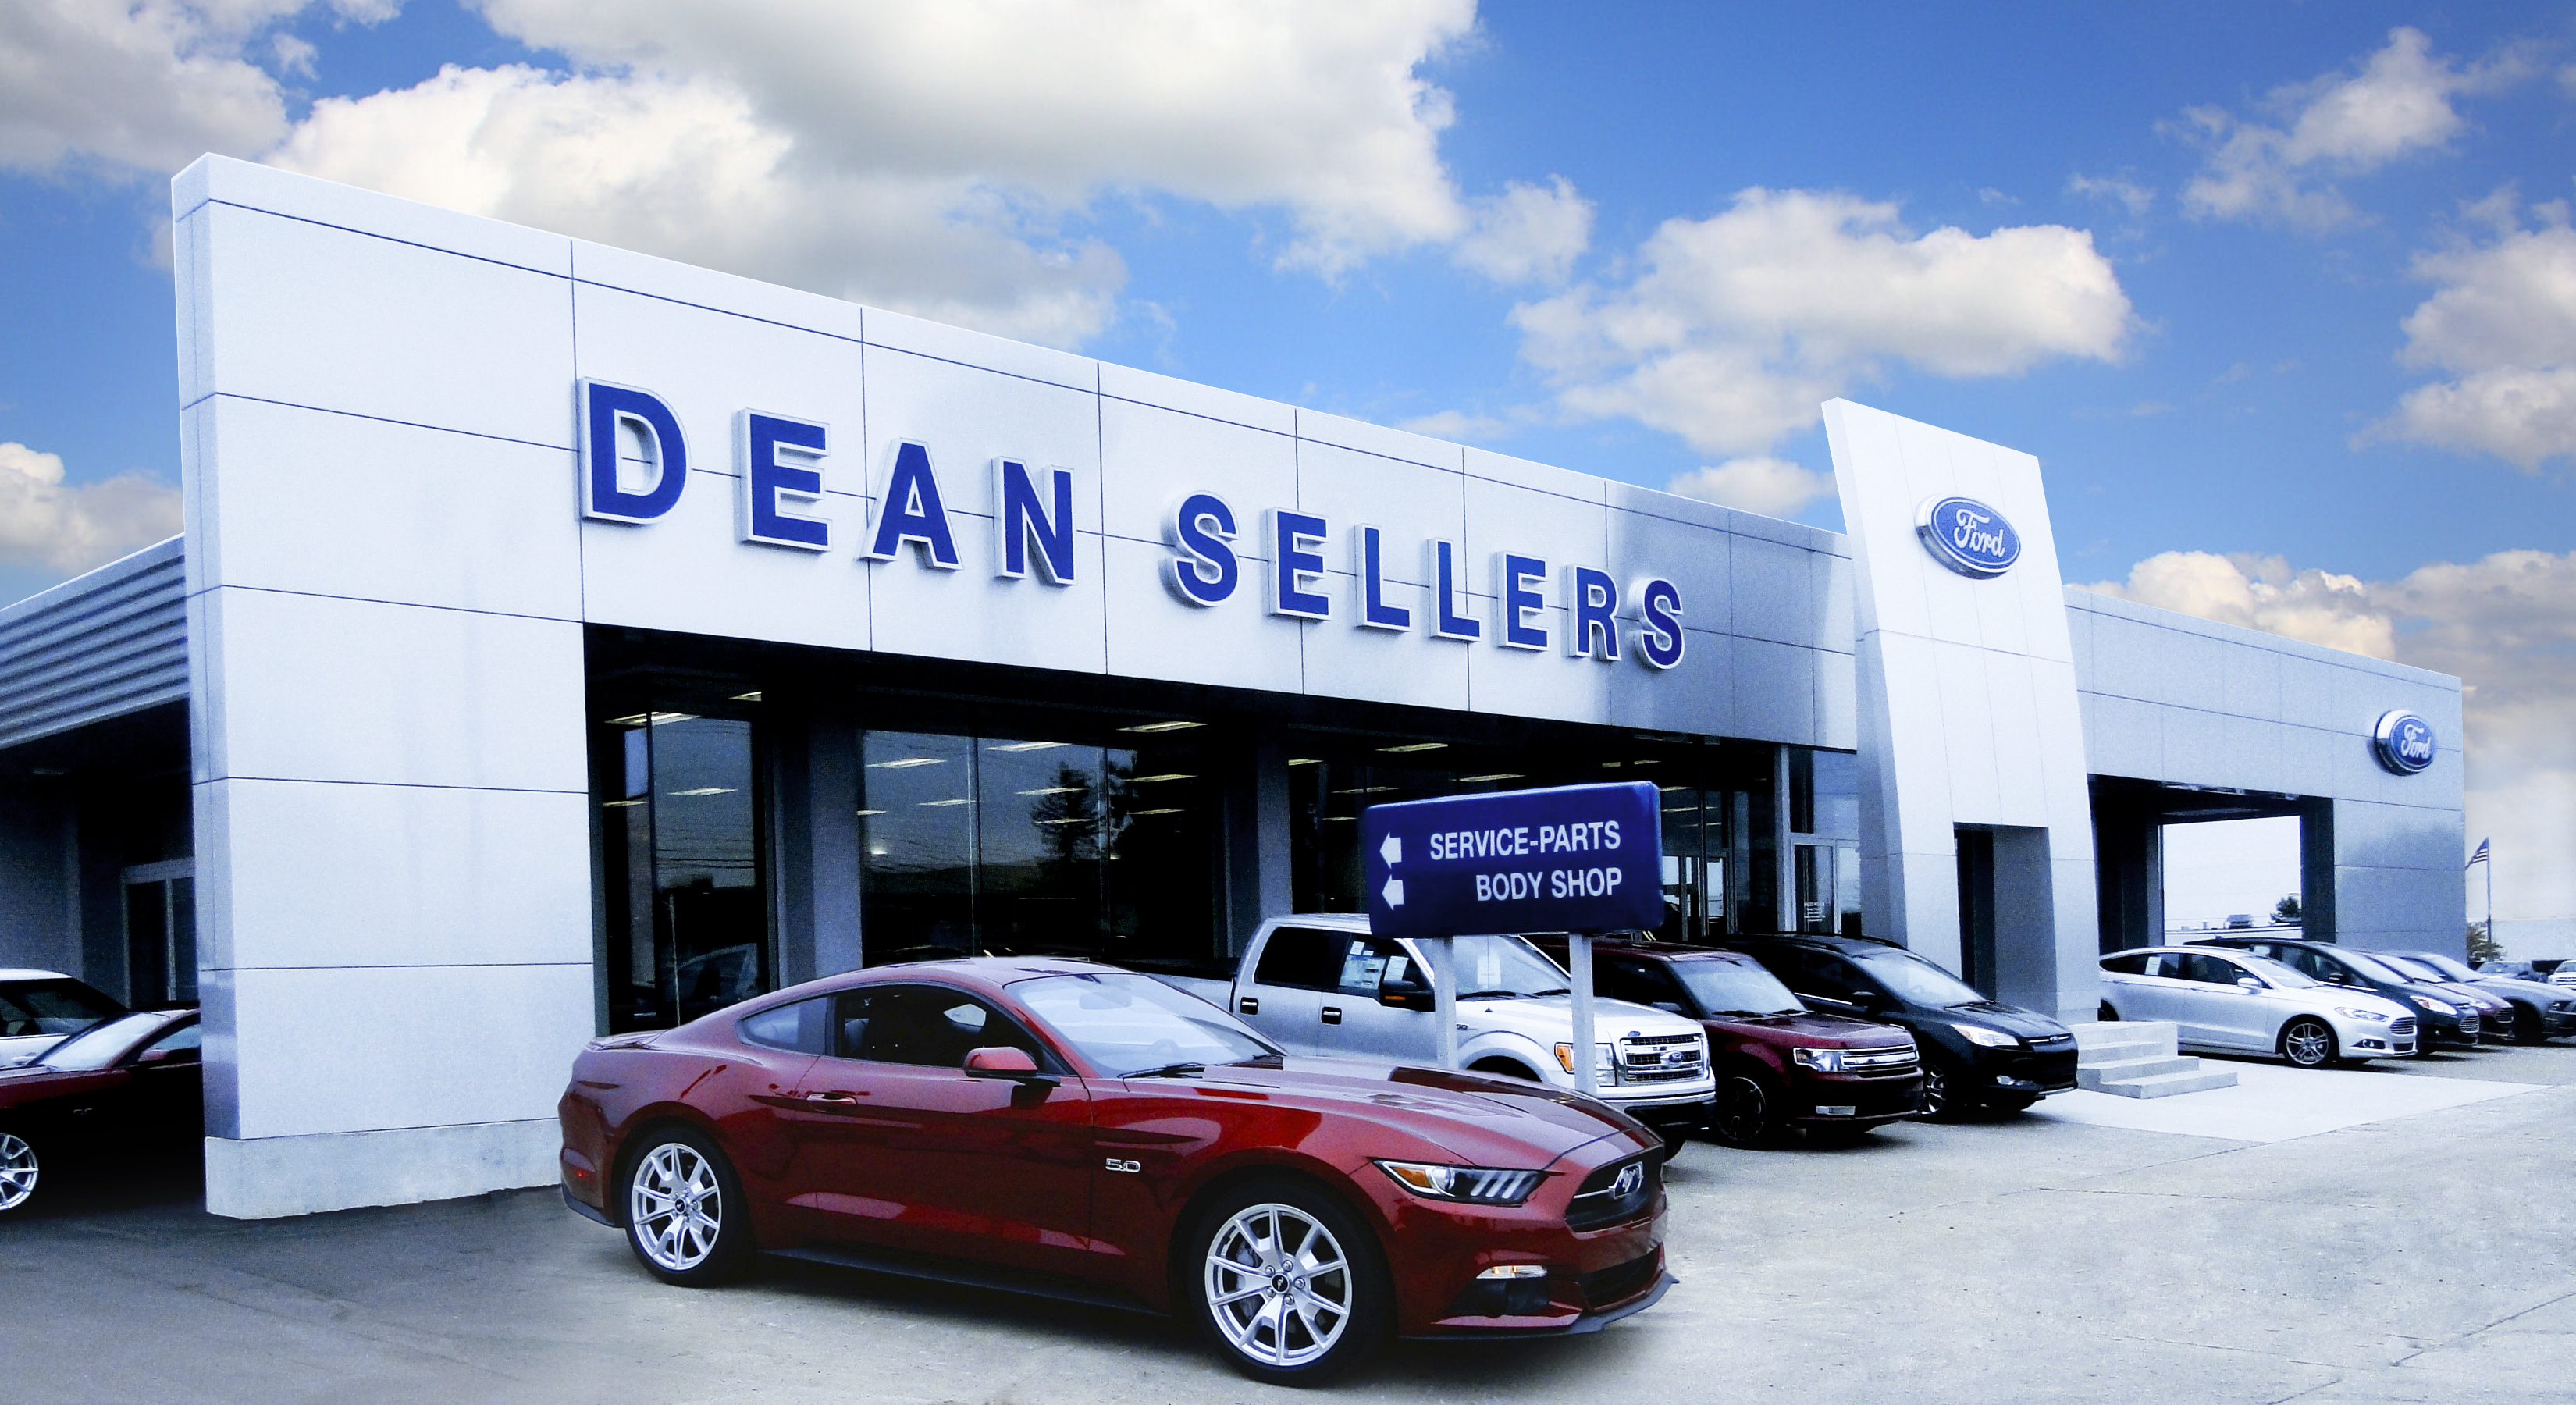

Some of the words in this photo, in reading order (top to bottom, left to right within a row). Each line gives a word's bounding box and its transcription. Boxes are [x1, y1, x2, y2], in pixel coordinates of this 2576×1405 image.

[580, 377, 1077, 586] DEAN
[1165, 490, 1685, 670] SELLERS
[1953, 508, 2005, 557] Ford
[2400, 724, 2431, 759] Ford
[1429, 820, 1621, 860] SERVICE-PARTS
[1475, 871, 1543, 902] BODY
[1550, 867, 1623, 898] SHOP
[1105, 1158, 1141, 1173] 5.0
